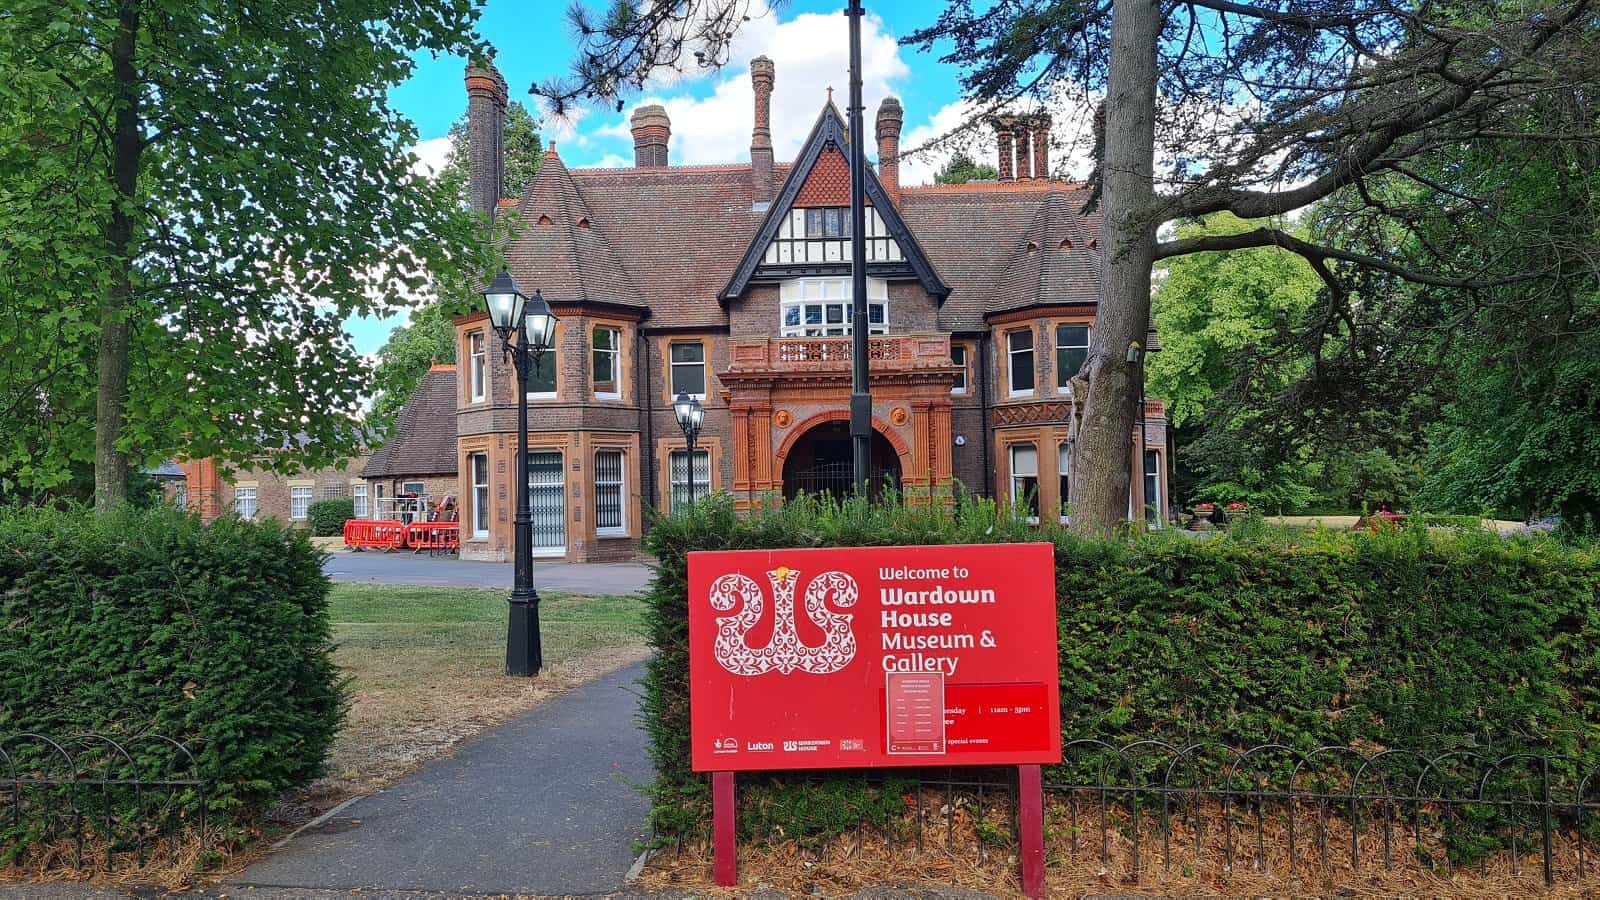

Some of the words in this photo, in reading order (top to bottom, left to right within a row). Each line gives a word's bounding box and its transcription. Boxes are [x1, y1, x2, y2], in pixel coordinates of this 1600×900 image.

[879, 565, 950, 580] Welcome
[952, 565, 969, 579] to
[880, 585, 996, 605] Wardown
[881, 610, 953, 628] House
[881, 632, 974, 650] Museum
[979, 629, 997, 648] &
[882, 652, 959, 676] Gallery
[747, 741, 774, 751] Luton
